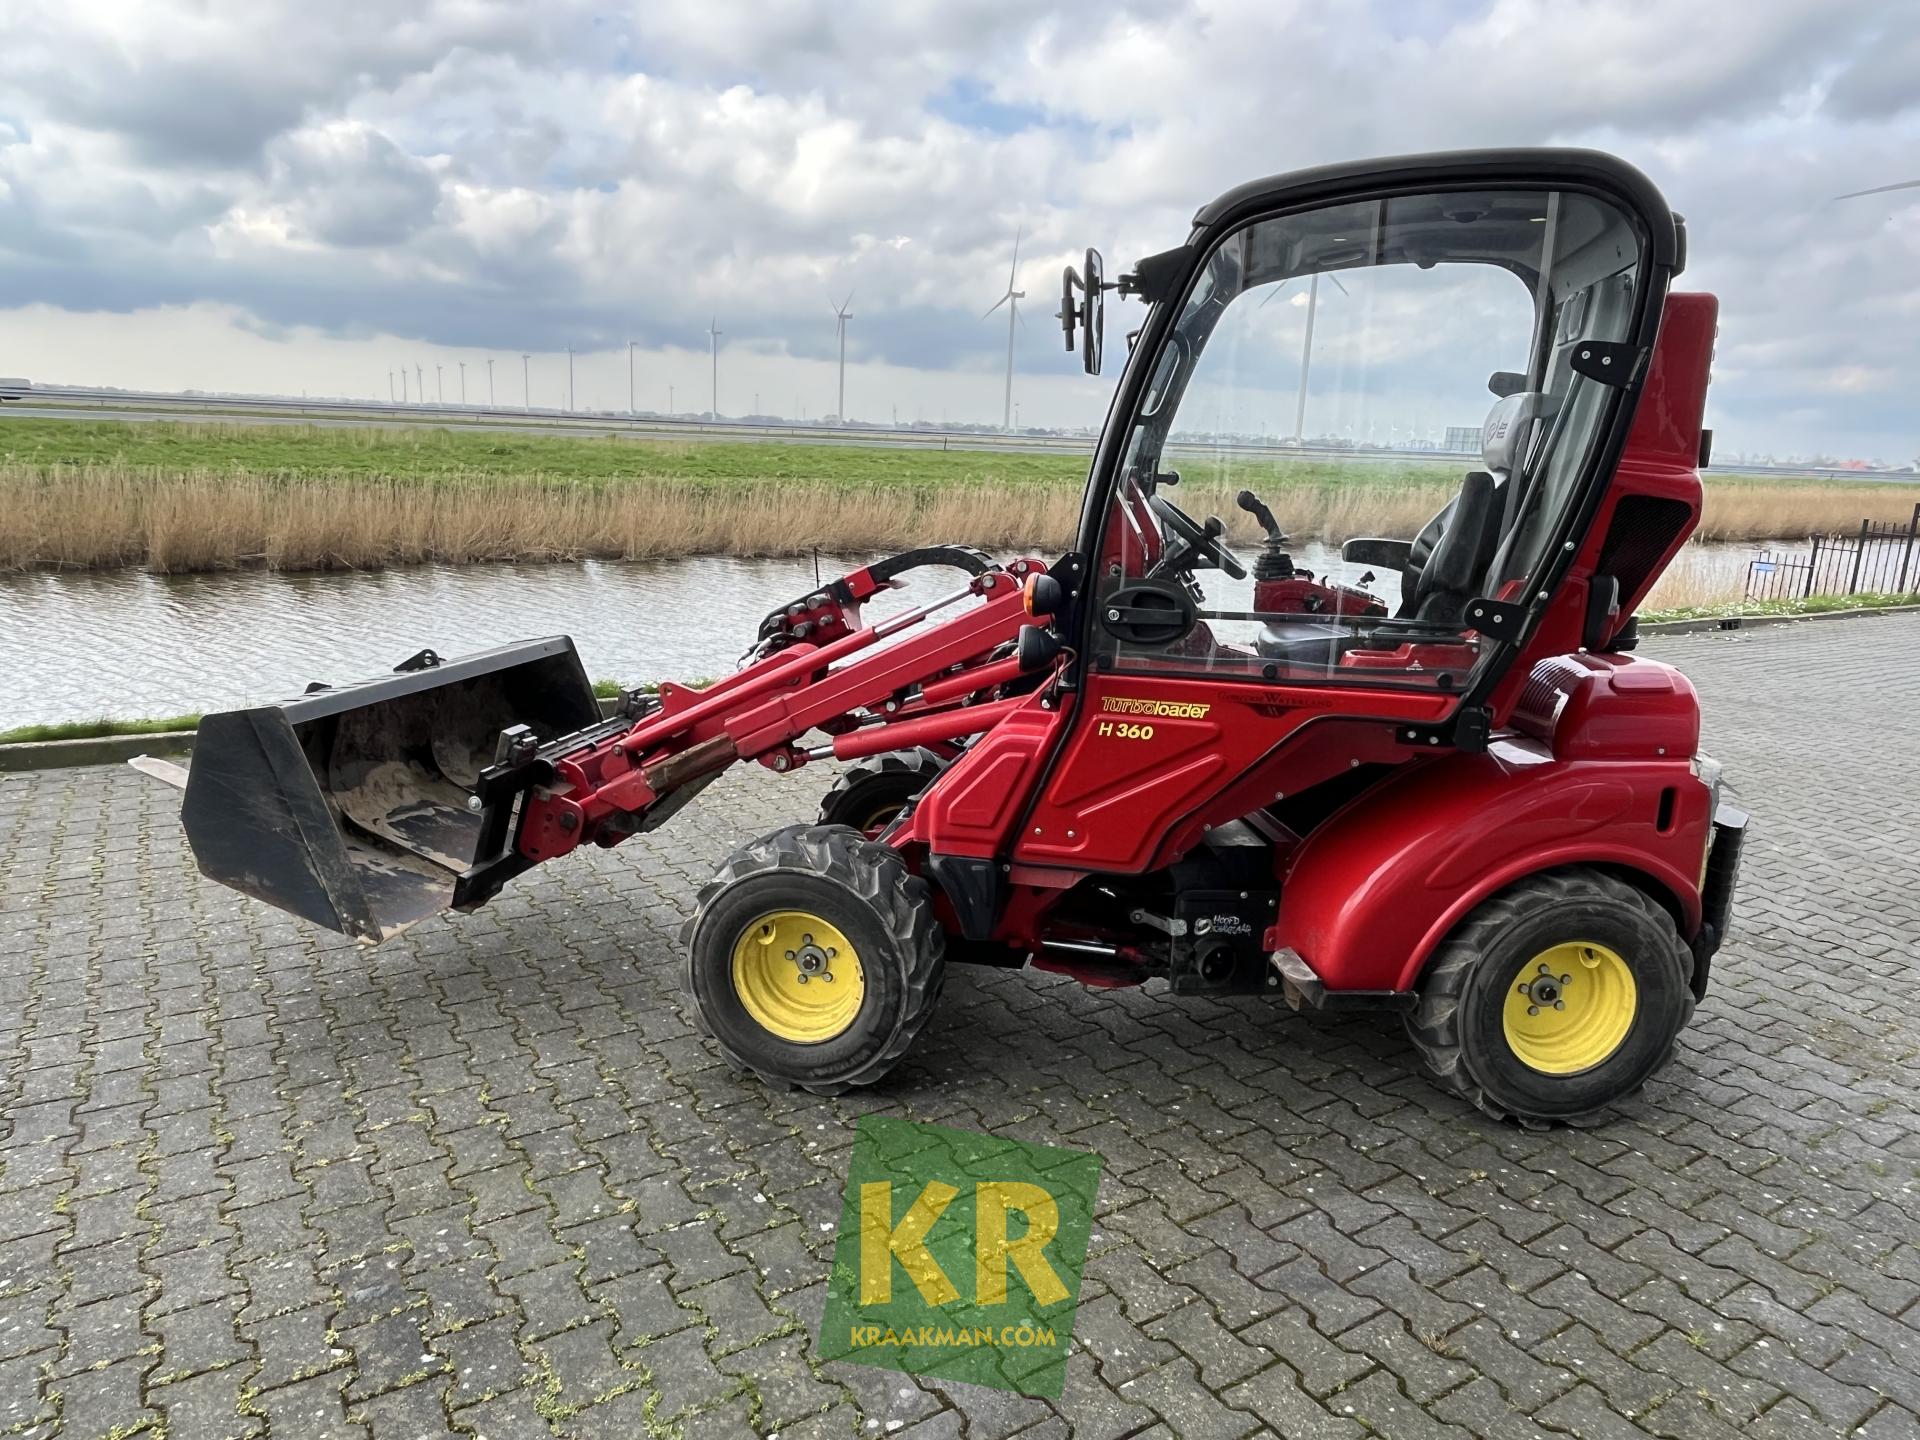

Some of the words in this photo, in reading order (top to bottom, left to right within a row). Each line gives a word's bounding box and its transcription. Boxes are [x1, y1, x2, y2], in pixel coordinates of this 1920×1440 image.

[1101, 696, 1211, 719] Turboloader
[1098, 722, 1113, 737] H
[1116, 723, 1154, 740] 360
